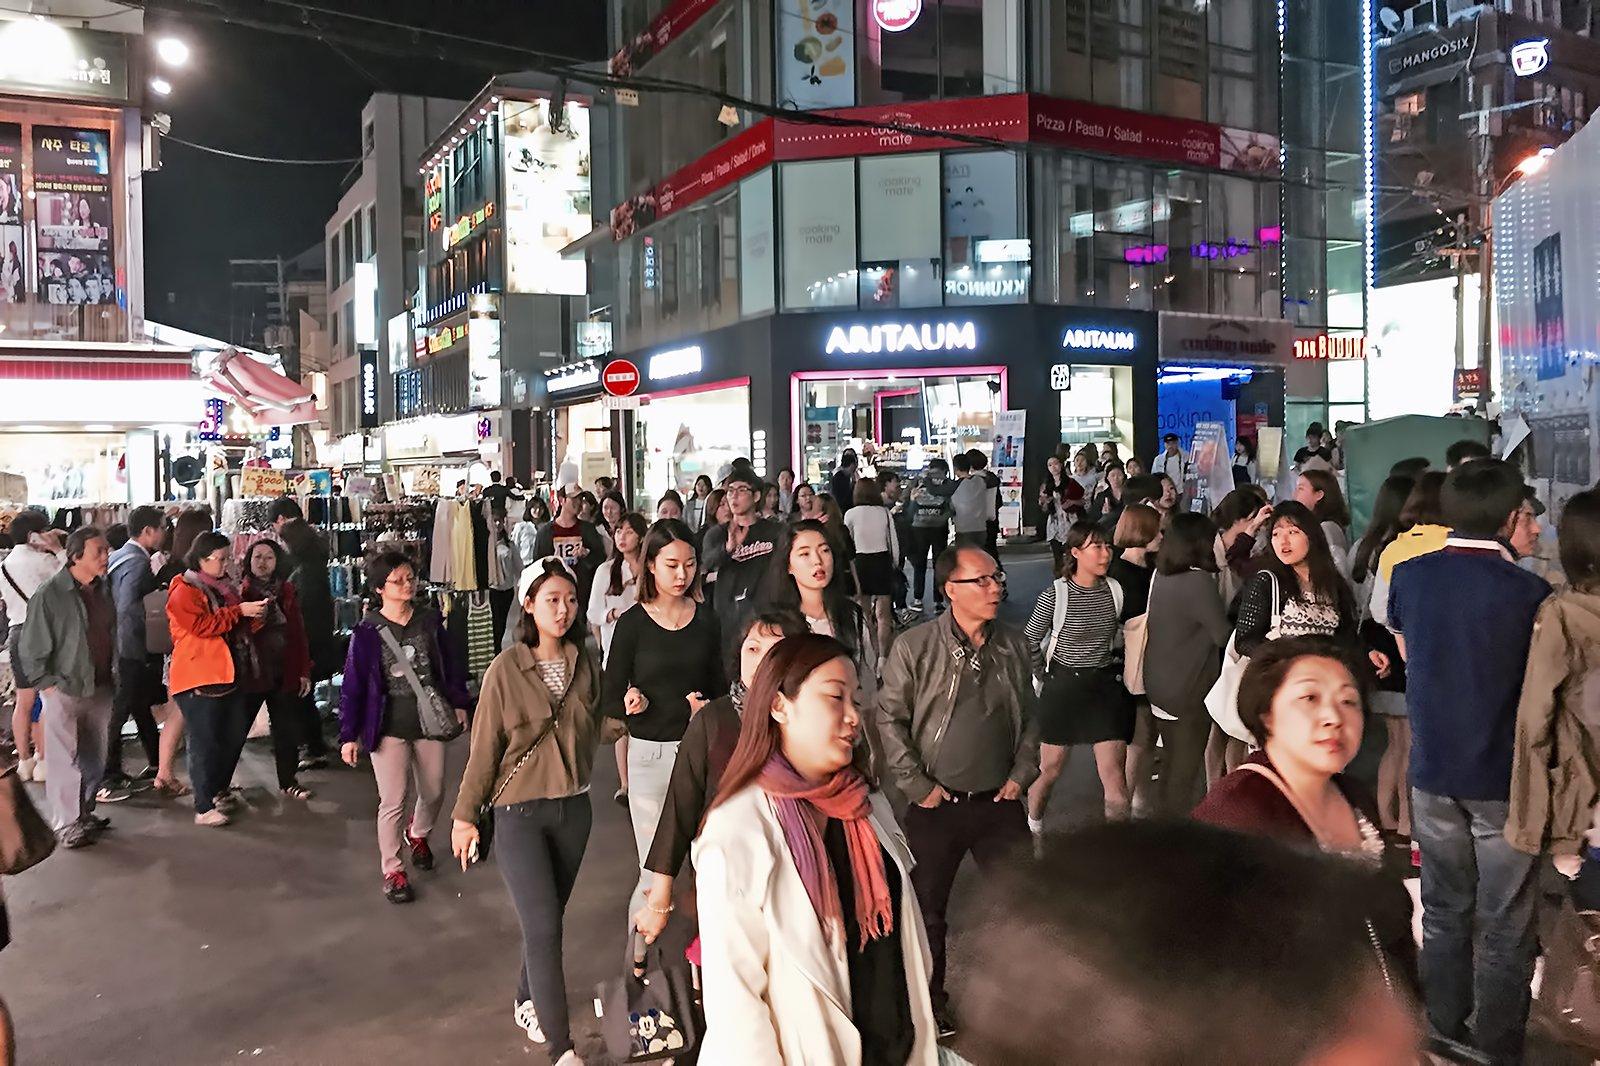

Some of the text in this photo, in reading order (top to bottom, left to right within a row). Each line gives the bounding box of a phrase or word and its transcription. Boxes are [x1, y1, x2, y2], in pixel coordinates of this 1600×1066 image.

[1402, 36, 1470, 69] MANGOSIX
[879, 134, 913, 146] mate
[1036, 113, 1065, 132] Pizza
[1075, 119, 1104, 138] Pasta
[1114, 125, 1142, 144] Salad
[1181, 137, 1215, 153] cooking
[825, 321, 976, 354] ARITAUM
[1062, 328, 1135, 351] ARITAUM
